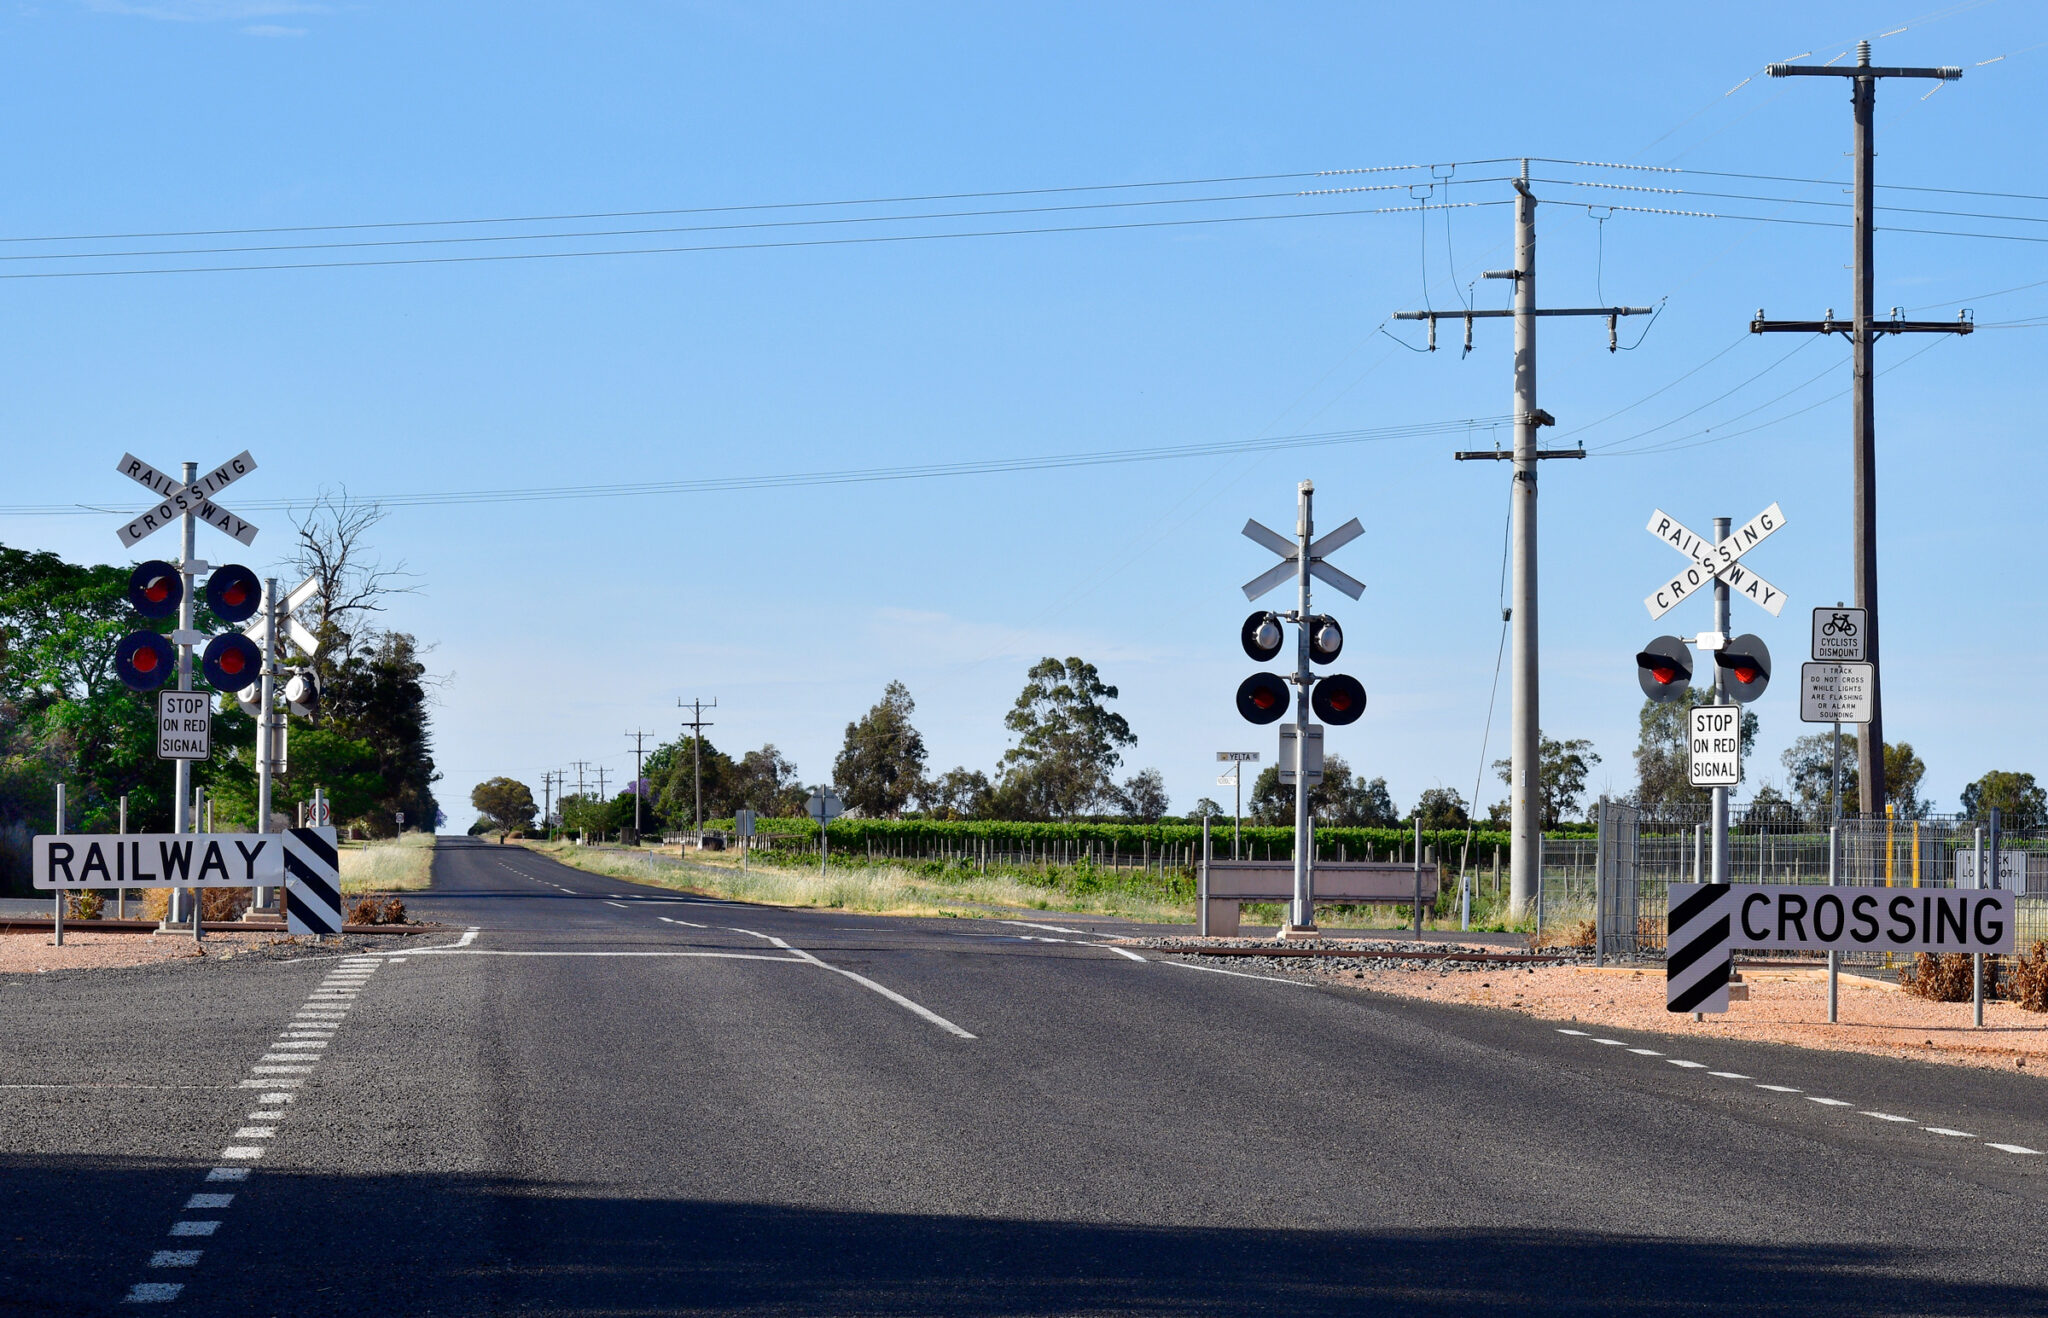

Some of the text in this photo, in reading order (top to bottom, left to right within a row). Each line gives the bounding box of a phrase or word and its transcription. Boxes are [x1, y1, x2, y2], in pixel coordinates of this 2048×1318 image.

[127, 460, 248, 537] RAIL WAY
[128, 459, 245, 539] CROSSING
[1656, 514, 1773, 608] CROSSING
[1657, 518, 1776, 605] RAIL WAY
[1821, 638, 1858, 647] CYCLISTS
[1820, 648, 1859, 657] DISMOUNT
[167, 698, 203, 714] STOP
[163, 719, 206, 732] ON RED
[1697, 714, 1732, 732] STOP
[162, 739, 206, 753] SIGNAL
[1693, 738, 1736, 753] ON RED
[1230, 753, 1250, 761] YELTA
[1694, 762, 1735, 777] SIGNAL
[48, 840, 267, 882] RAILWAY
[1963, 868, 1988, 878] LOK
[1741, 892, 2003, 946] CROSSING
